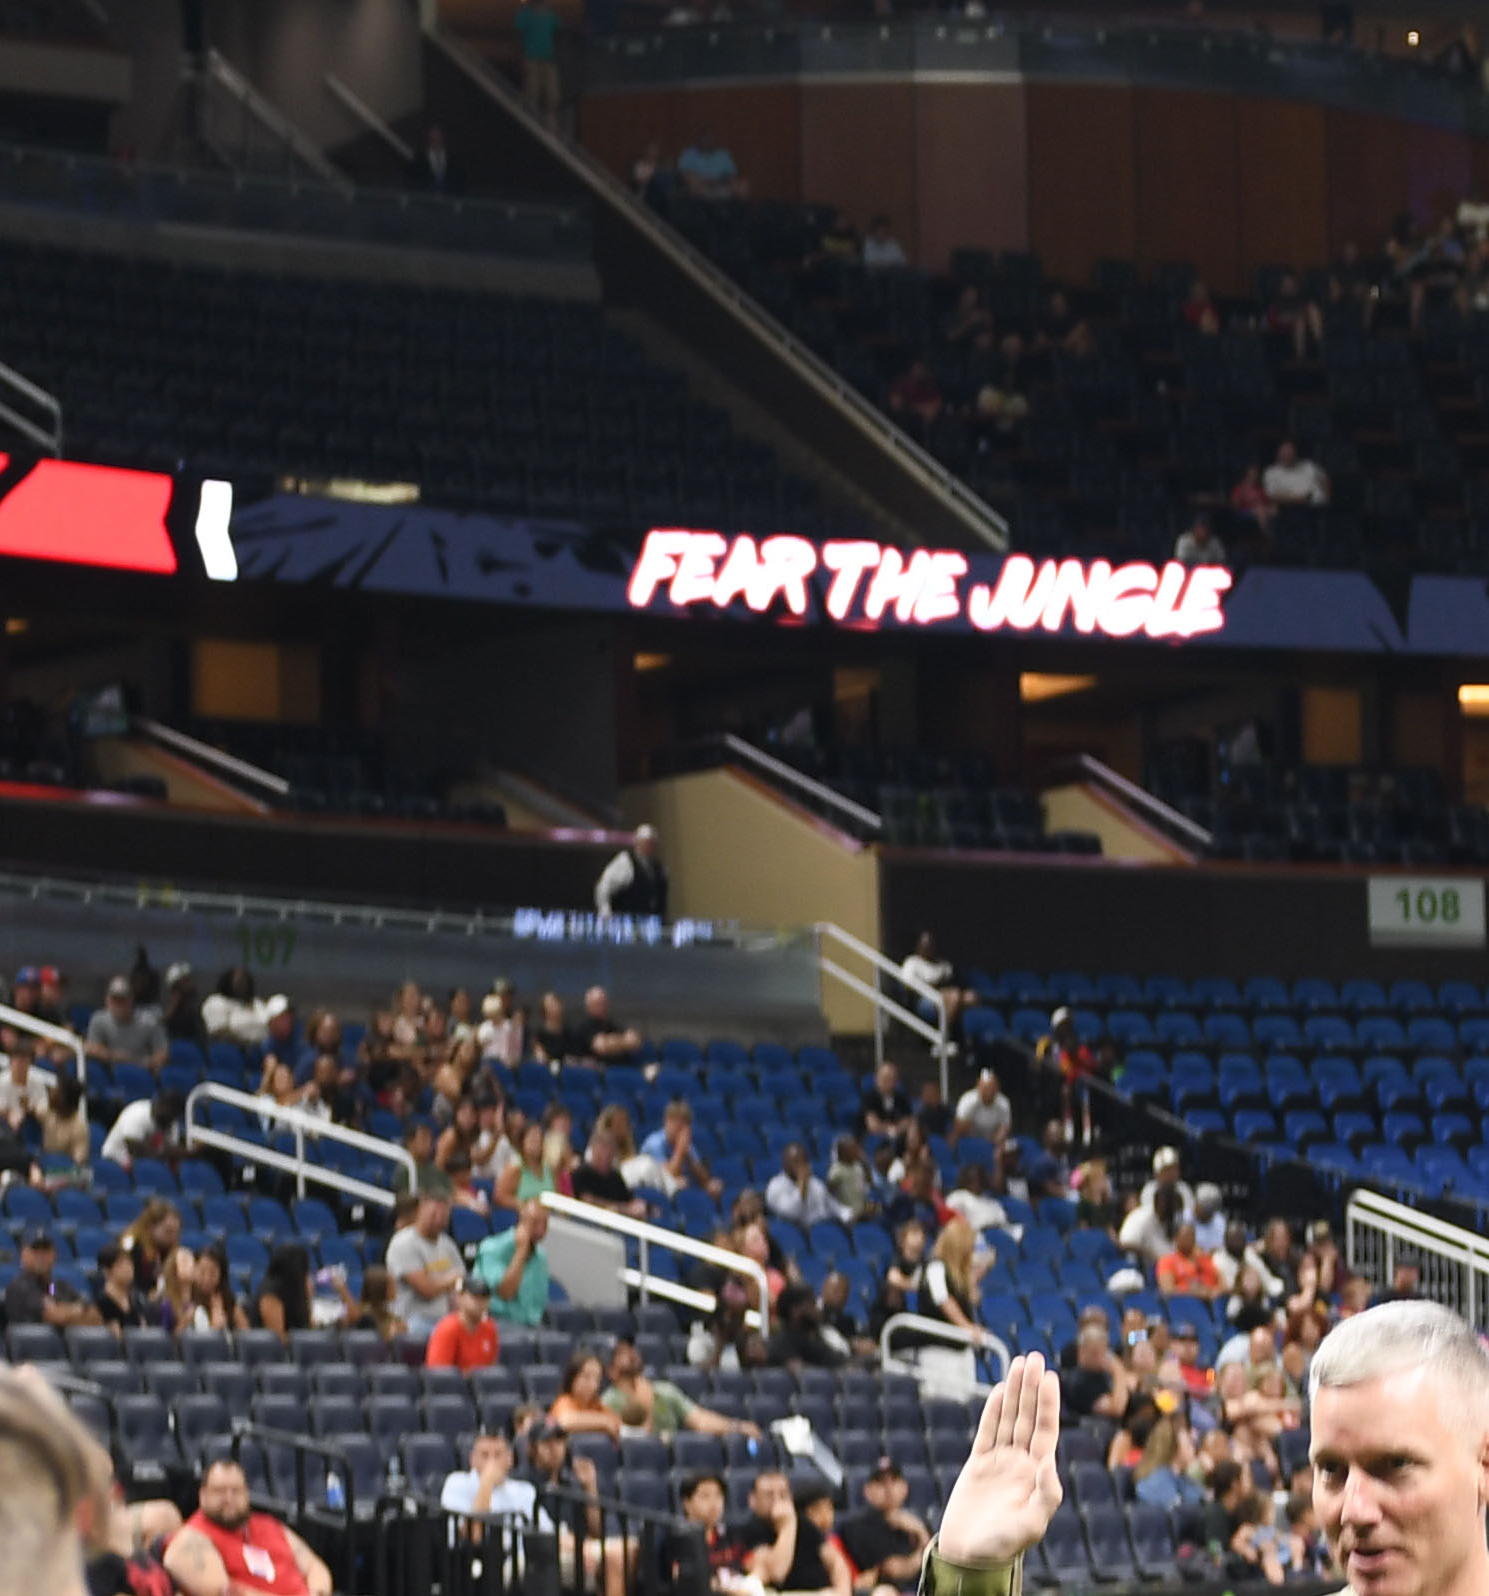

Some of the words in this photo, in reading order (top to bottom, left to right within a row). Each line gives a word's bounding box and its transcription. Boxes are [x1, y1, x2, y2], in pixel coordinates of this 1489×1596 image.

[627, 529, 817, 614] FEAR
[822, 539, 968, 624] THE
[968, 554, 1232, 637] JUNGLE
[1396, 886, 1460, 924] 108
[236, 923, 299, 967] 107
